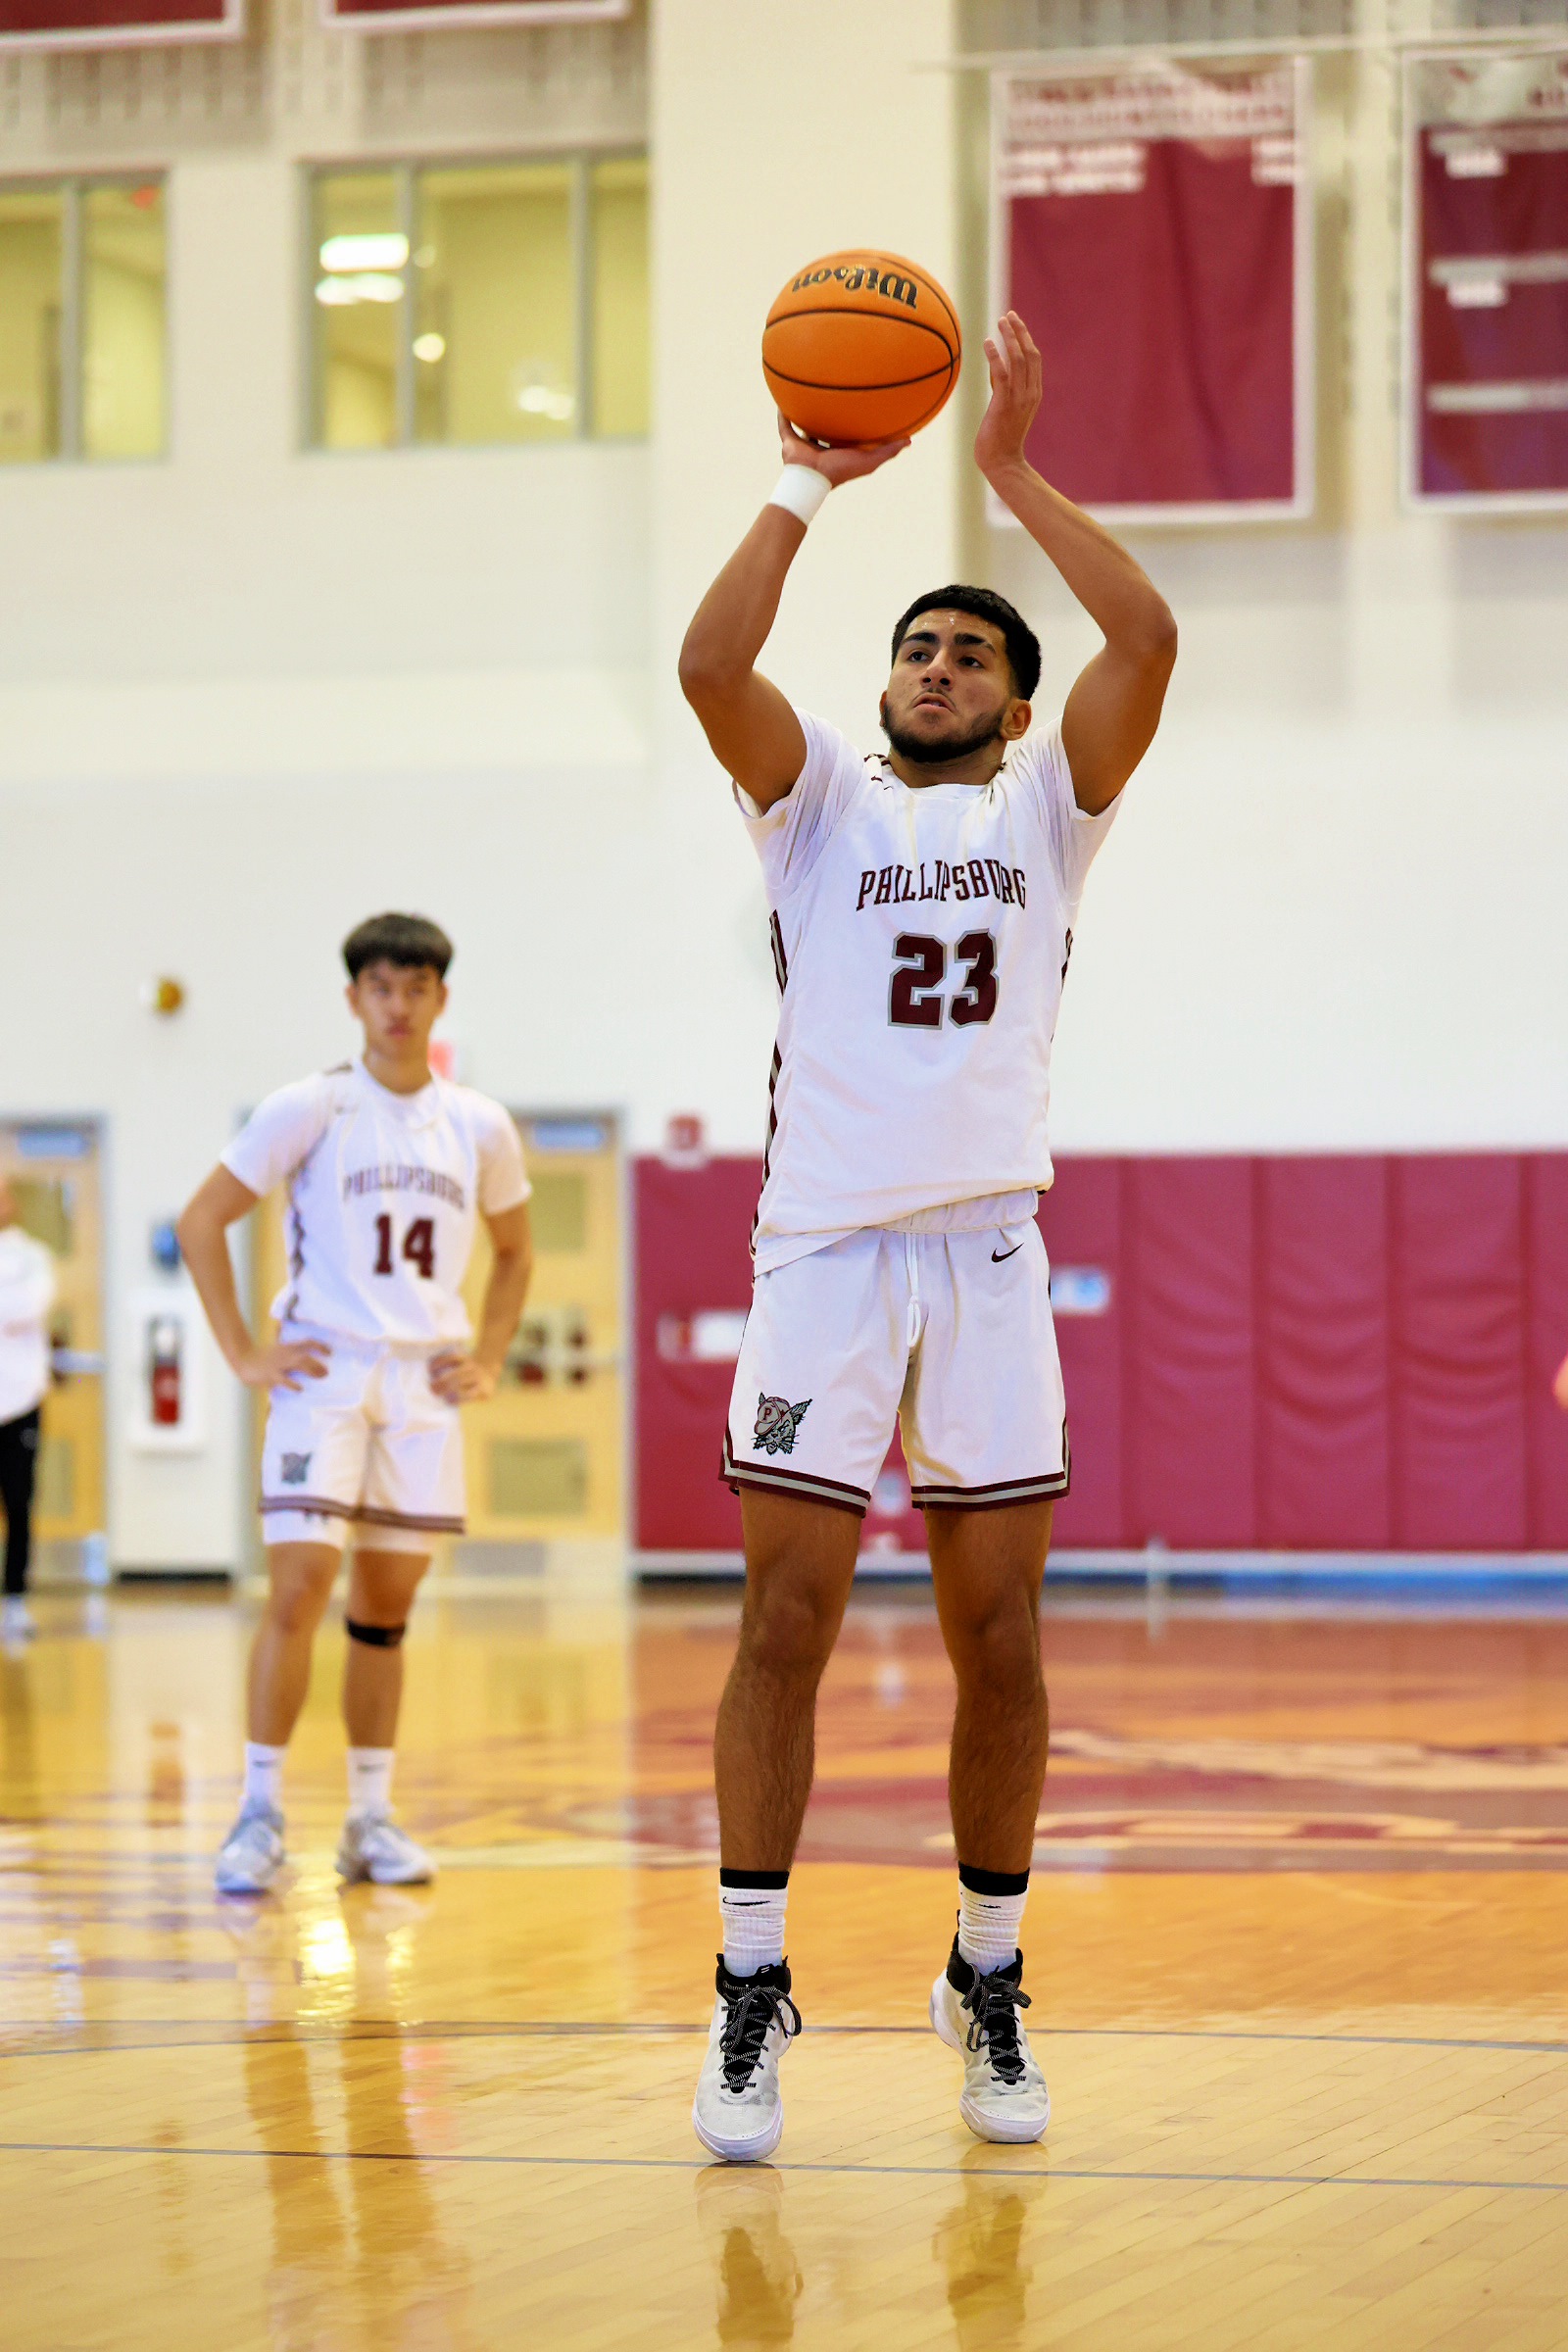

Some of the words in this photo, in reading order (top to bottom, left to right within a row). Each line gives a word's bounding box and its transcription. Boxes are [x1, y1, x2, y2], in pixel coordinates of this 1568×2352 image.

[792, 264, 918, 310] Wilson
[856, 858, 1026, 912] PHILLIPSBURG
[887, 927, 1001, 1031] 23
[374, 1211, 434, 1280] 14
[763, 1406, 772, 1421] P
